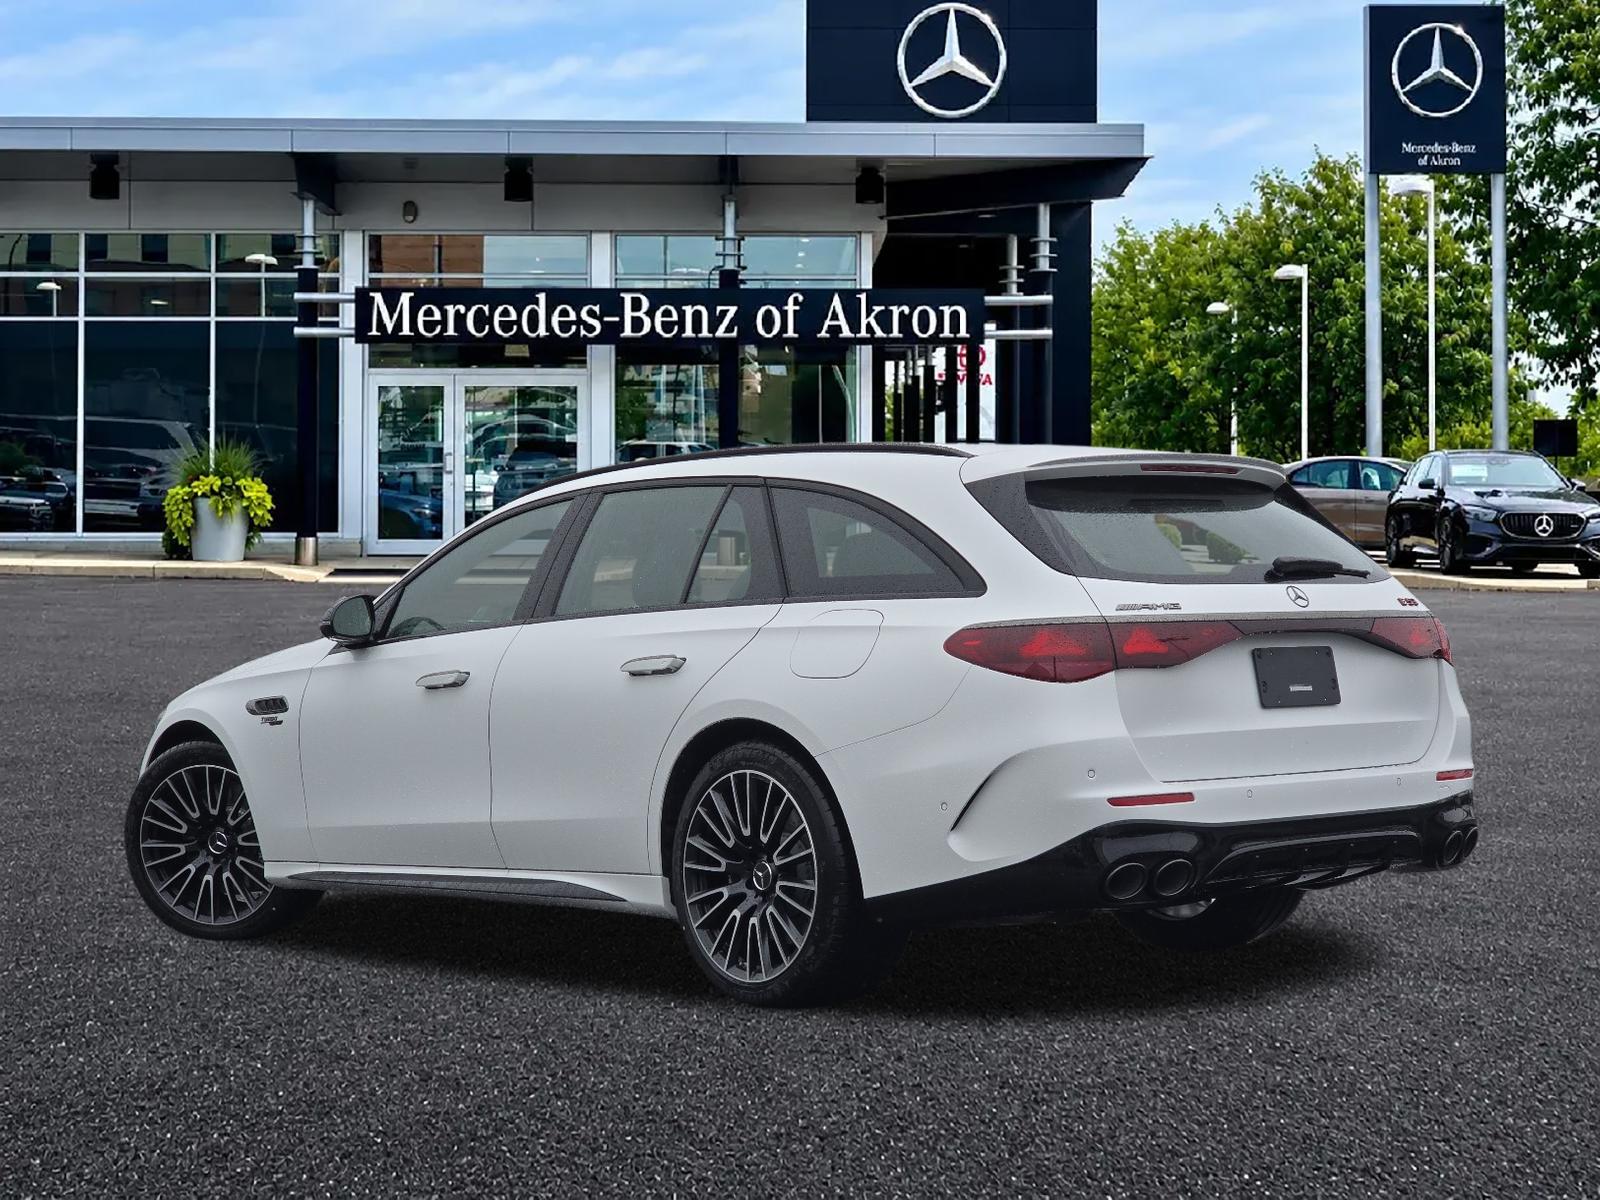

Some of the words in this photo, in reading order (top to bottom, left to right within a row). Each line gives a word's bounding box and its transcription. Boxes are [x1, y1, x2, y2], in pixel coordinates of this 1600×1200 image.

[1401, 141, 1477, 153] Mercedes-Benz
[1417, 154, 1428, 166] of
[1430, 154, 1461, 166] Akron
[366, 291, 738, 339] Mercedes-Benz
[755, 291, 803, 339] of
[816, 291, 970, 339] Akron
[1137, 603, 1182, 611] AMG
